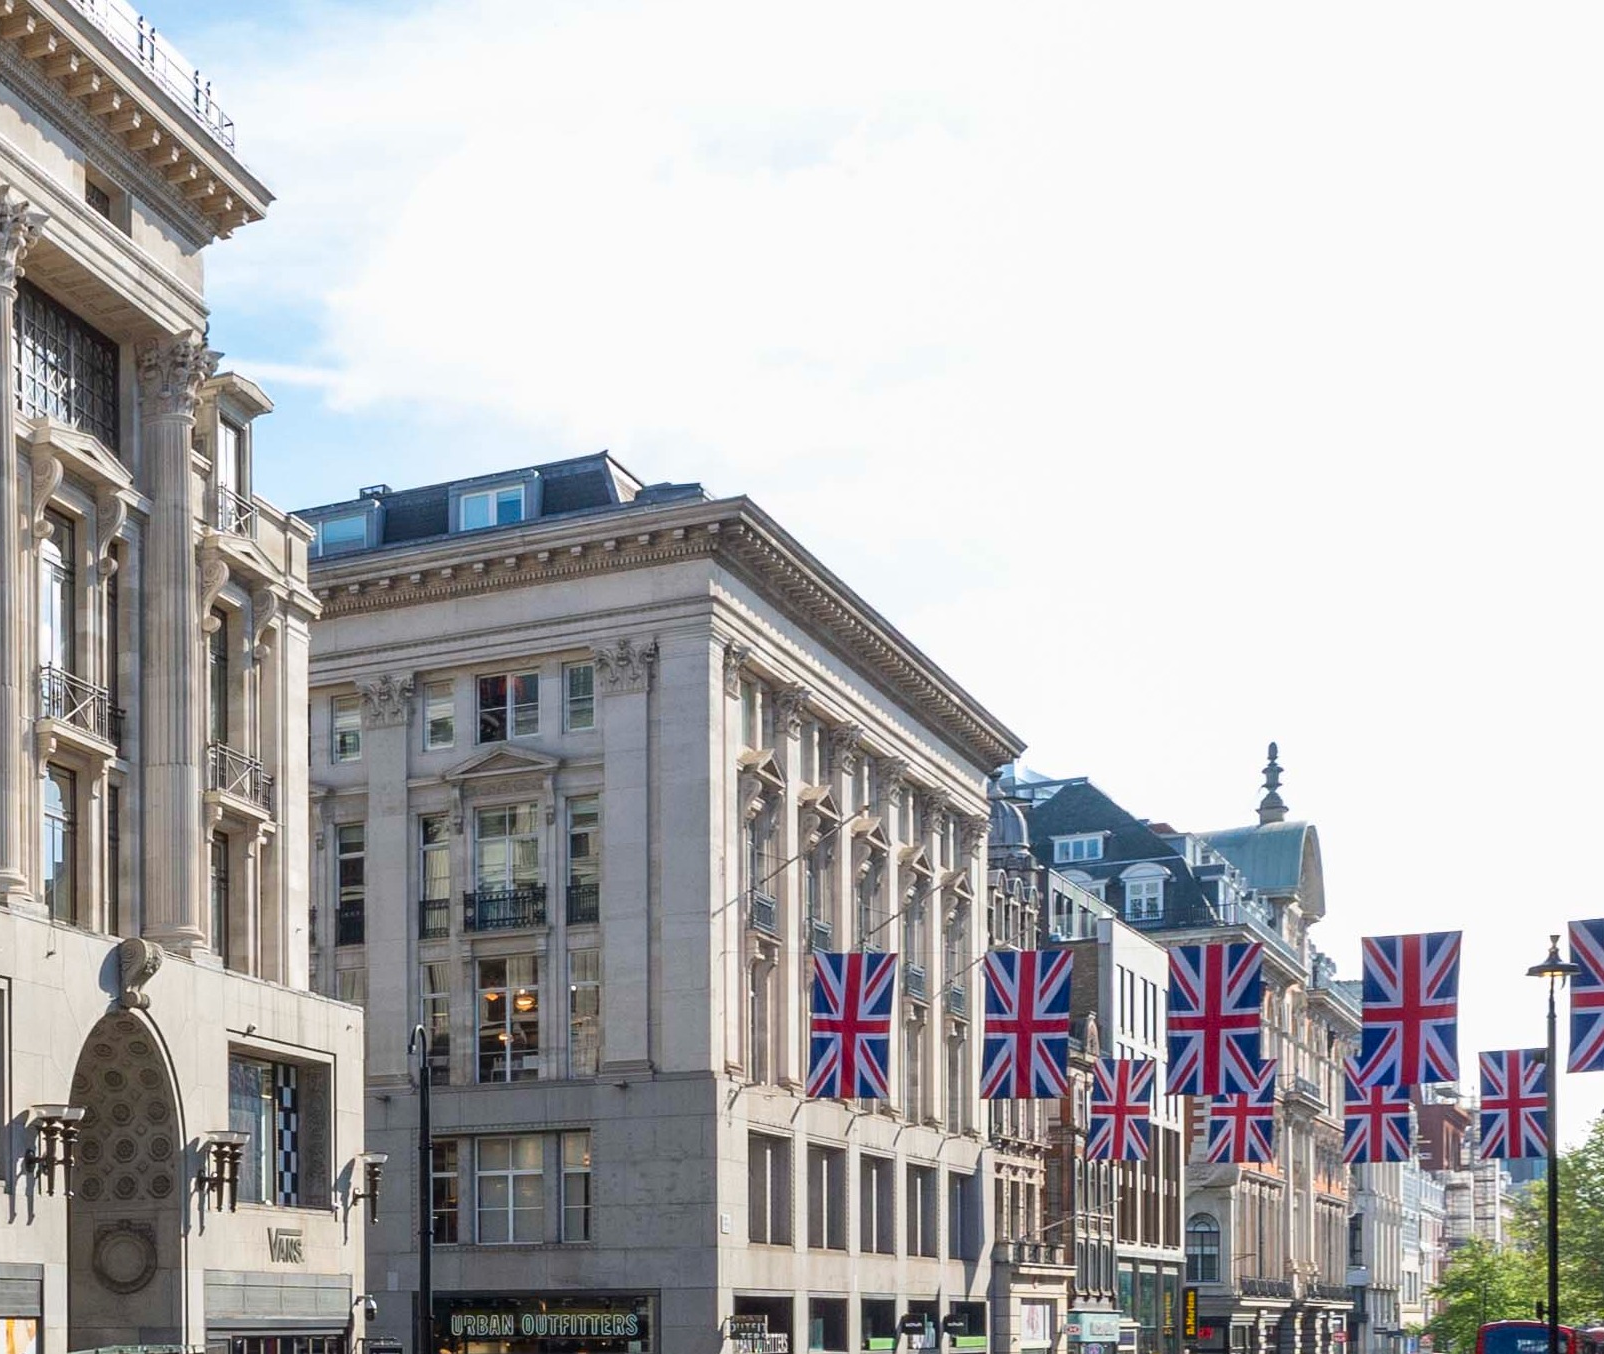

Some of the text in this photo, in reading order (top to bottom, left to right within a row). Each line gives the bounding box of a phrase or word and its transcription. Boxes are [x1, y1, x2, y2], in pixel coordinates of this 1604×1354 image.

[267, 1227, 304, 1263] VANS
[451, 1313, 639, 1337] URBAN OUTFITTERS
